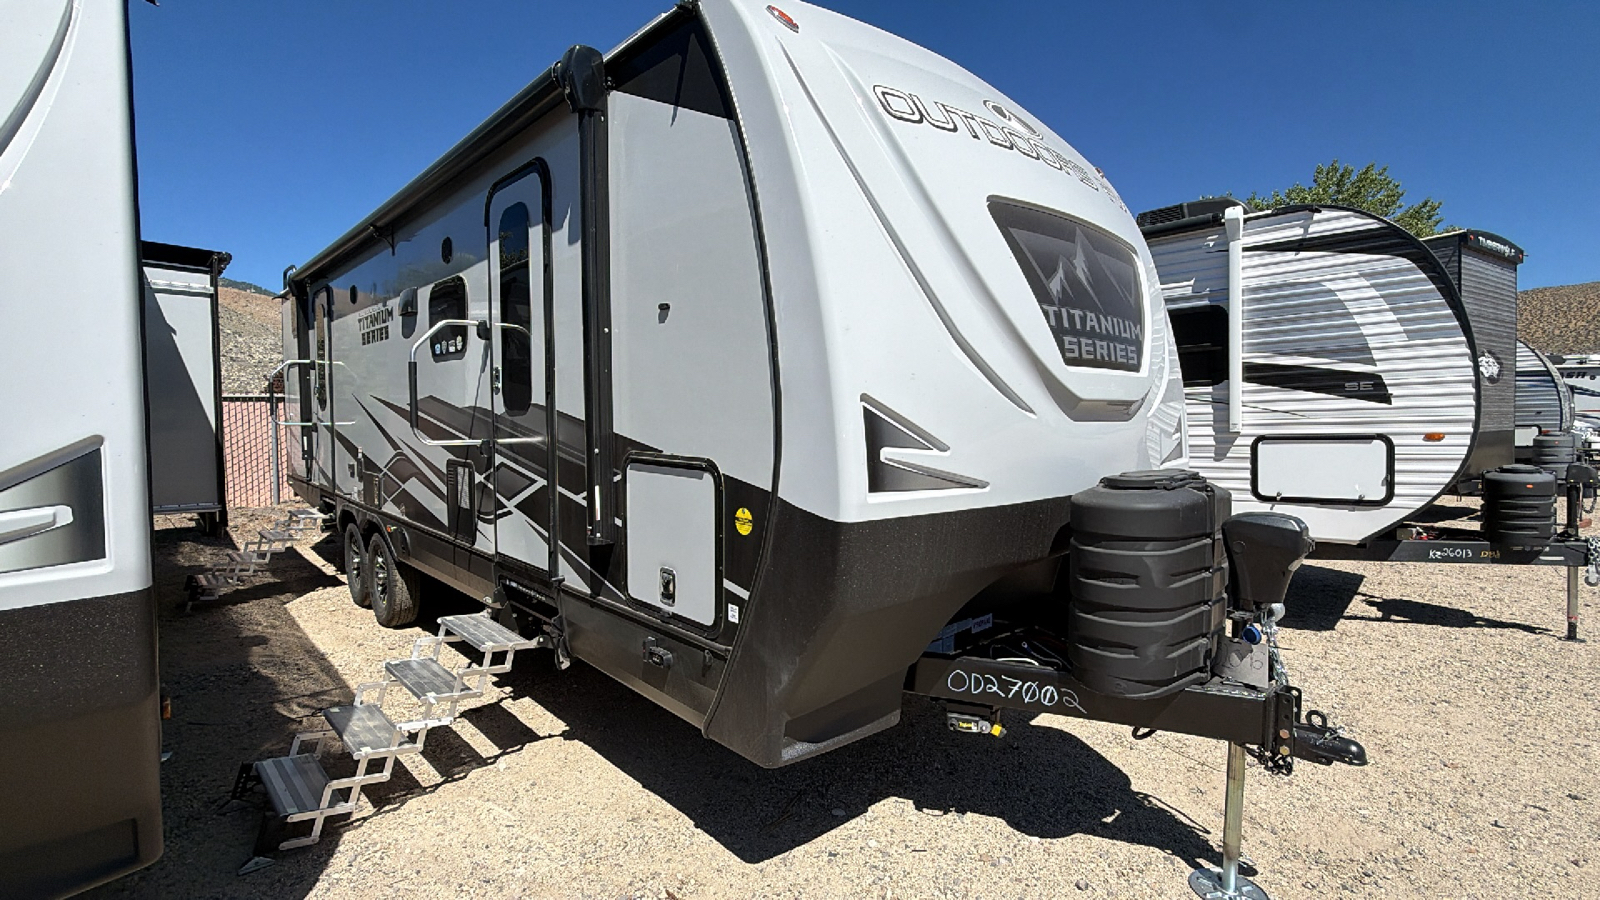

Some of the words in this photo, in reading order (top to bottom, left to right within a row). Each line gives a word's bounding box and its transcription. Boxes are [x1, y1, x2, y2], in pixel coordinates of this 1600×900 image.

[358, 306, 394, 332] TITANIUM
[1041, 304, 1143, 341] TITANIUM
[362, 325, 390, 346] SERIES
[1063, 336, 1139, 365] SERIES
[1344, 381, 1374, 391] SE
[947, 669, 1089, 715] OD27002
